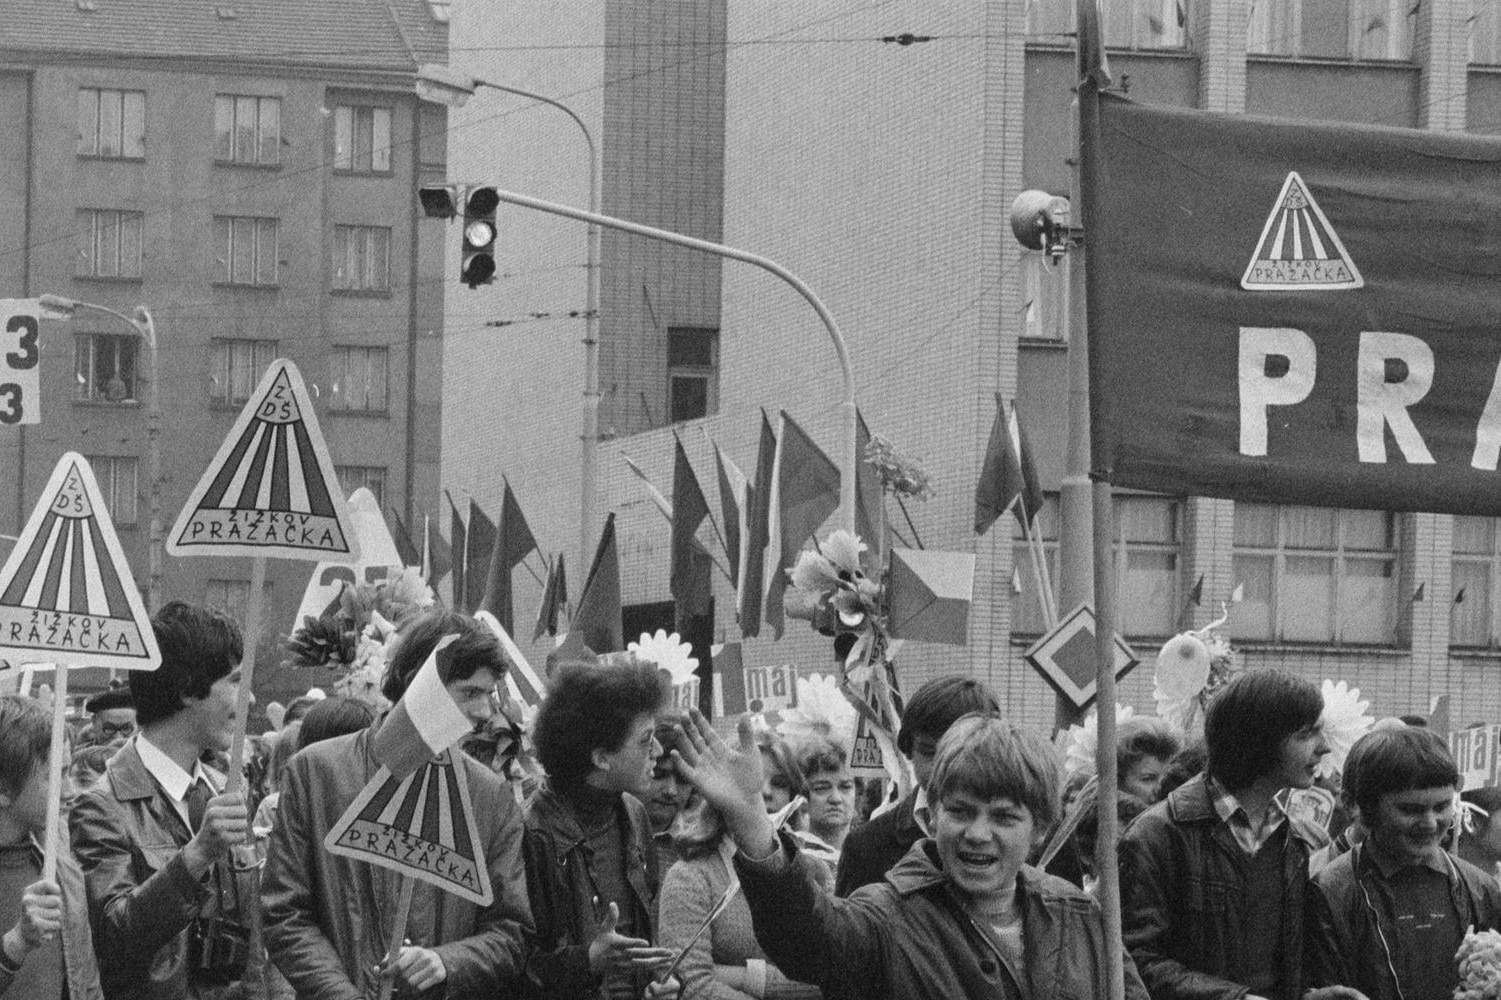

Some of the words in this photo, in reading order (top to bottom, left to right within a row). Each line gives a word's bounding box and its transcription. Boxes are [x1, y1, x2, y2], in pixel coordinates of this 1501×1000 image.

[6, 315, 39, 371] 3
[274, 386, 285, 399] Z
[262, 401, 291, 420] DŠ
[69, 477, 78, 490] Z
[57, 494, 84, 513] DŠ
[229, 510, 310, 525] ŽIŽKOV
[192, 521, 334, 547] PRAŽAČKA
[30, 610, 106, 630] ŽIŽKOV
[383, 826, 448, 856] ŽIŽKOV
[350, 829, 474, 887] PRAŽAČKA
